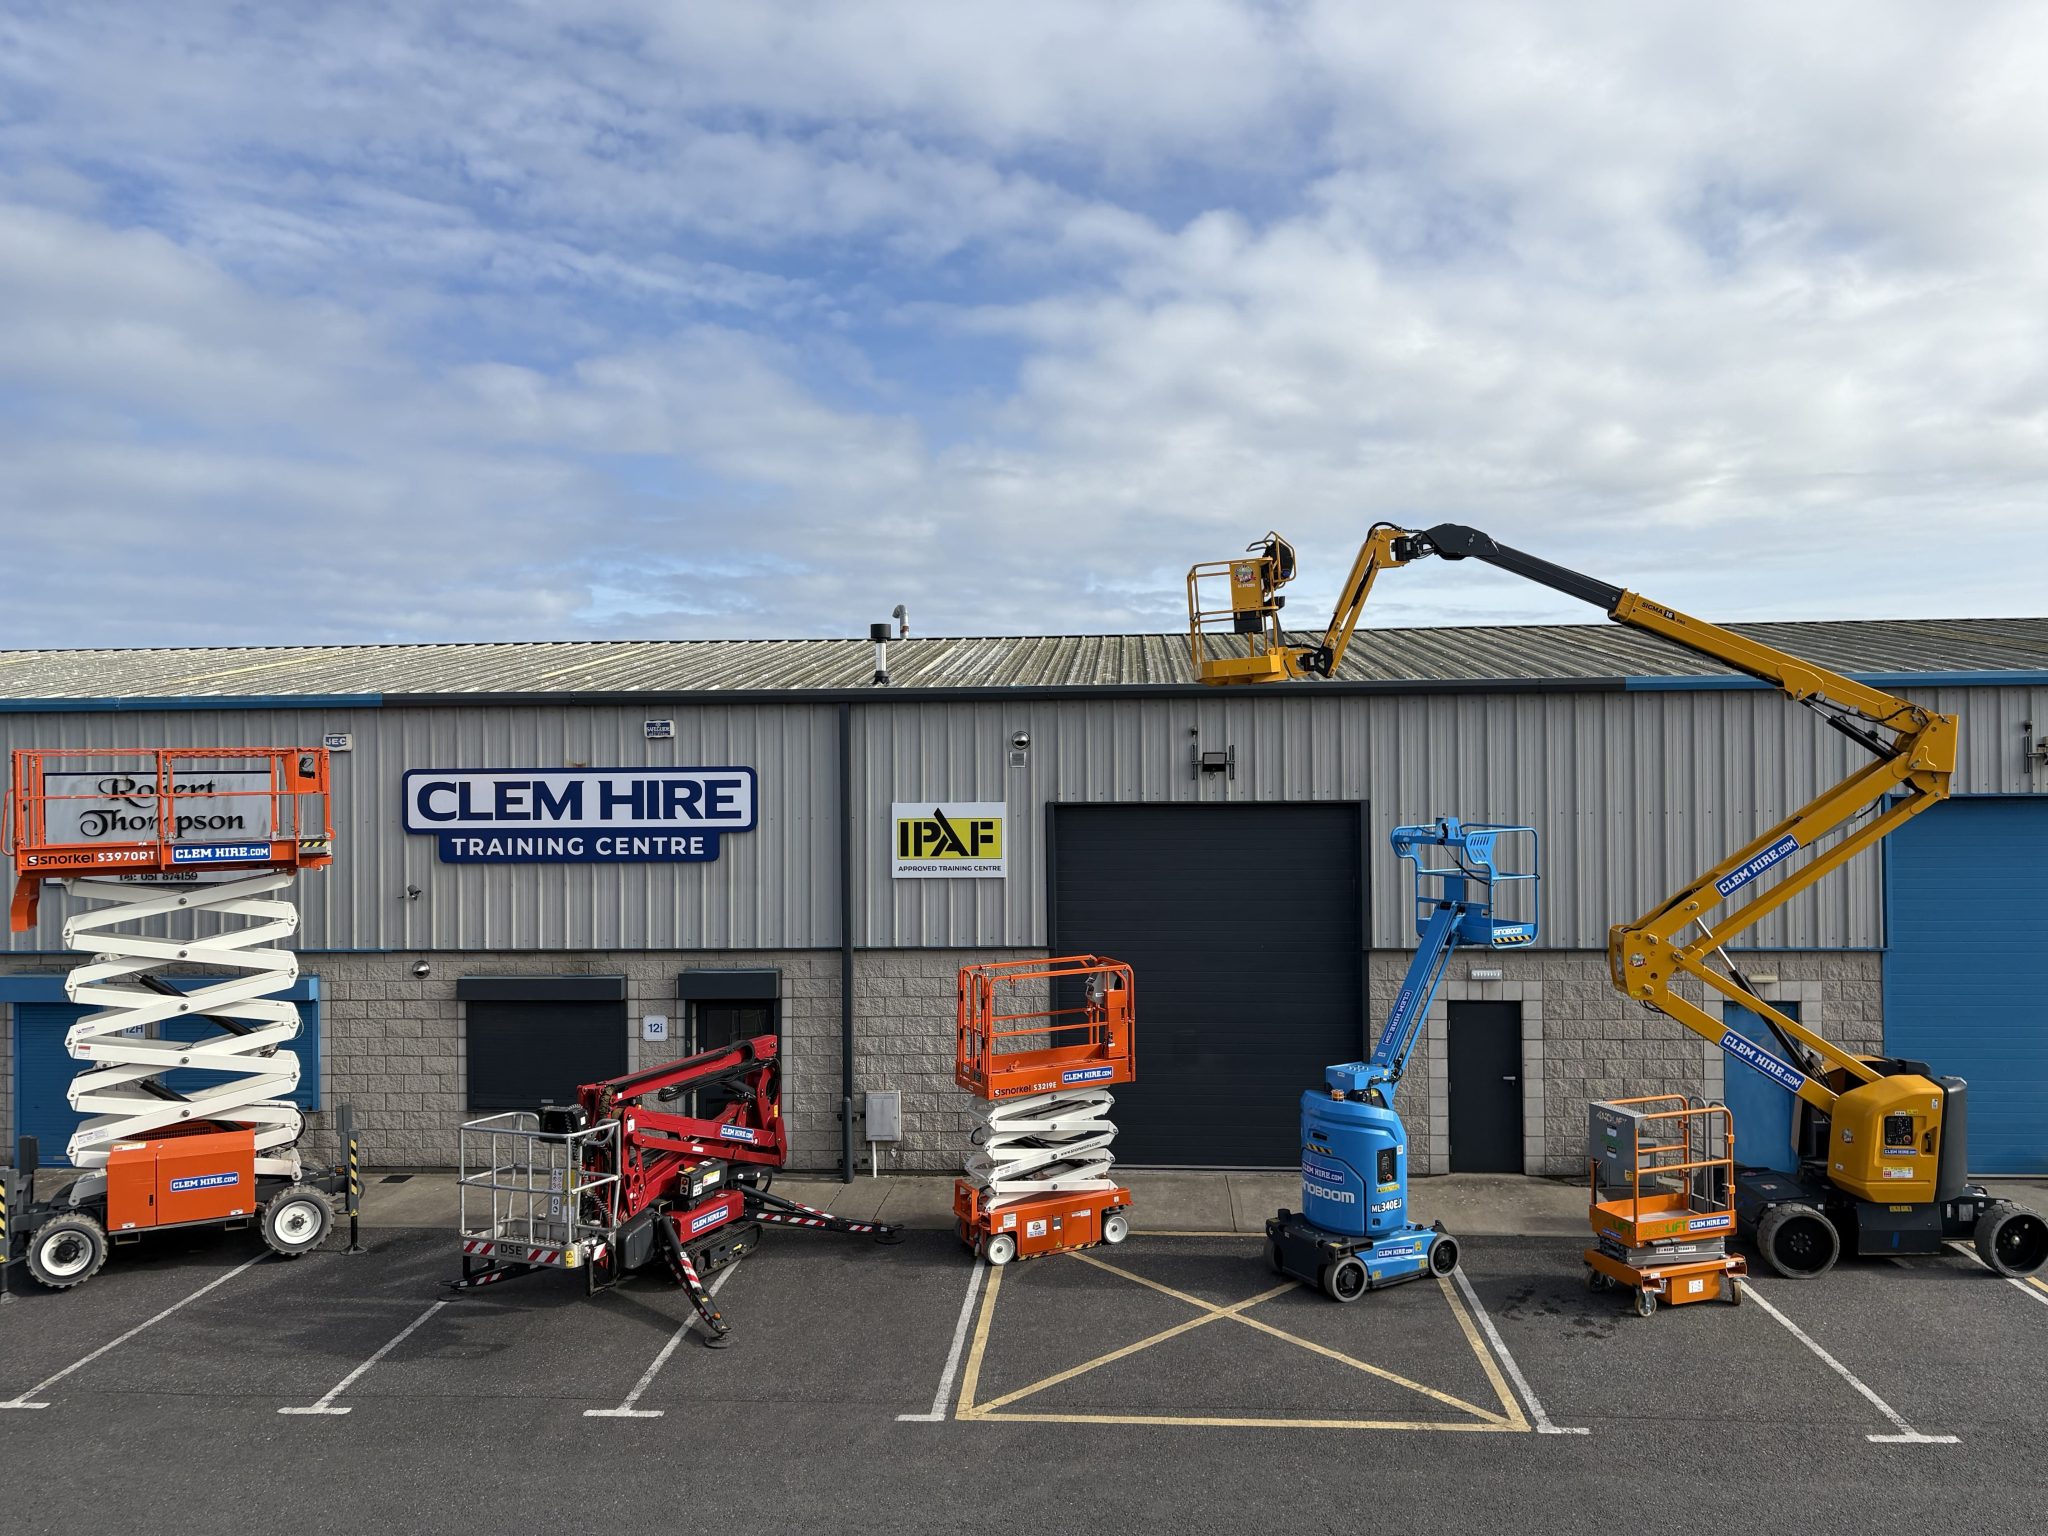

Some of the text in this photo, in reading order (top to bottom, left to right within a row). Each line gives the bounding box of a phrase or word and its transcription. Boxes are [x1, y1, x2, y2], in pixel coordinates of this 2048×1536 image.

[1641, 601, 1663, 614] SIGMA
[325, 737, 347, 746] JEC
[98, 778, 216, 808] Roert
[417, 779, 742, 821] CLEM HIRE
[900, 808, 994, 857] IPAF
[174, 847, 269, 860] CLEM HIRE.COM
[451, 836, 705, 857] TRAINING CENTRE
[40, 853, 95, 865] snorkel
[97, 851, 155, 863] S3970RT
[1719, 839, 1796, 894] CLEM HIRE.COM
[1398, 991, 1411, 1012] CLEM
[1723, 1035, 1802, 1088] CLEM HIRE.COM
[1063, 1072, 1084, 1081] CLEM
[1001, 1085, 1031, 1096] snorkel
[1033, 1082, 1057, 1091] S3219E
[721, 1126, 735, 1136] CLEM
[173, 1176, 237, 1190] CLEM HIRE.COM
[1371, 1198, 1402, 1213] ML340EJ
[693, 1219, 707, 1230] CLEM
[1689, 1221, 1706, 1230] CLEM
[500, 1243, 522, 1255] DSE
